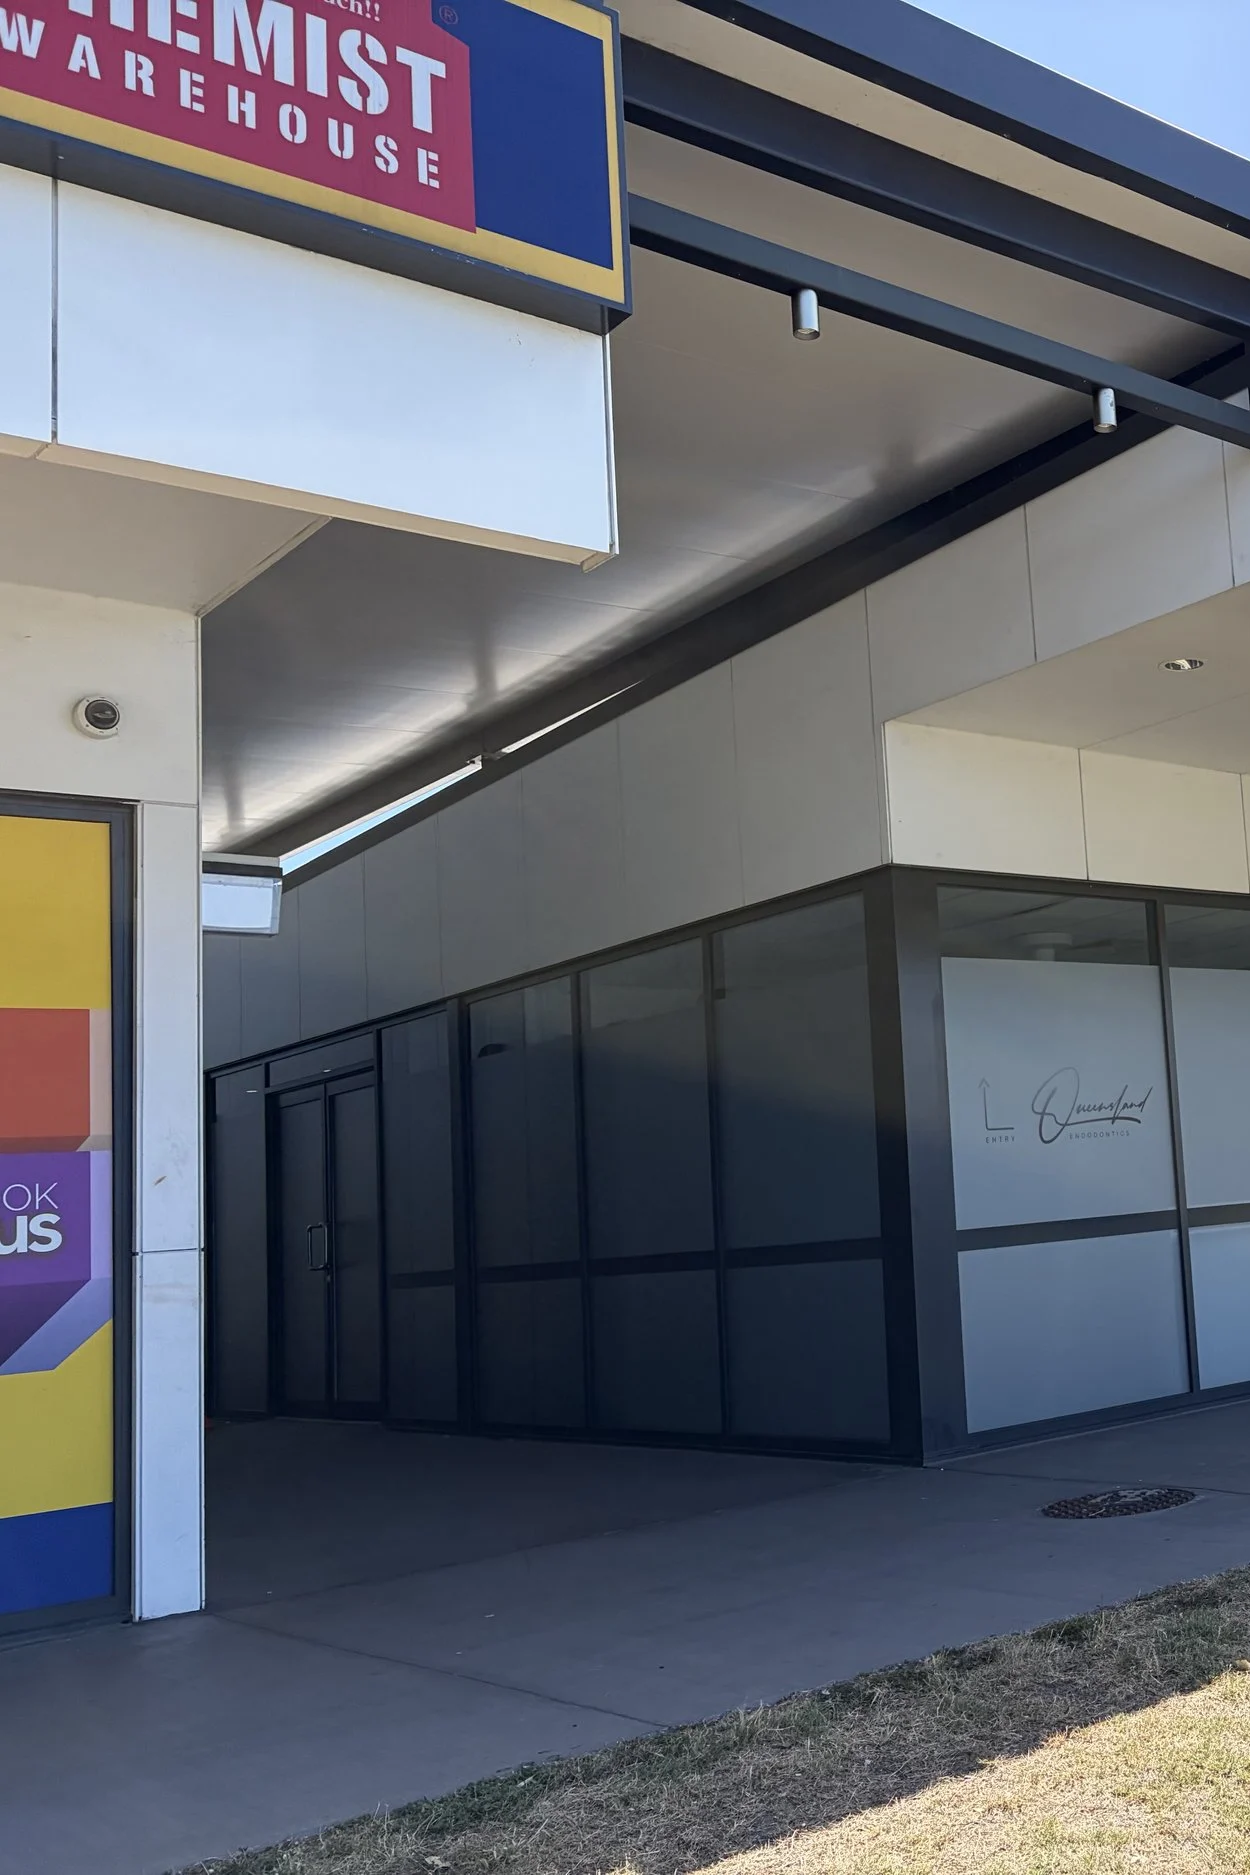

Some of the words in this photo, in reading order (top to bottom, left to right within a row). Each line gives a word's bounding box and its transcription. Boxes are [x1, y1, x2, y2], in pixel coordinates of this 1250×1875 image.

[0, 7, 440, 189] WAREHOUSE
[985, 1135, 1015, 1144] ENTRY
[1069, 1130, 1130, 1140] ENDODONTICS
[3, 1182, 58, 1211] OK
